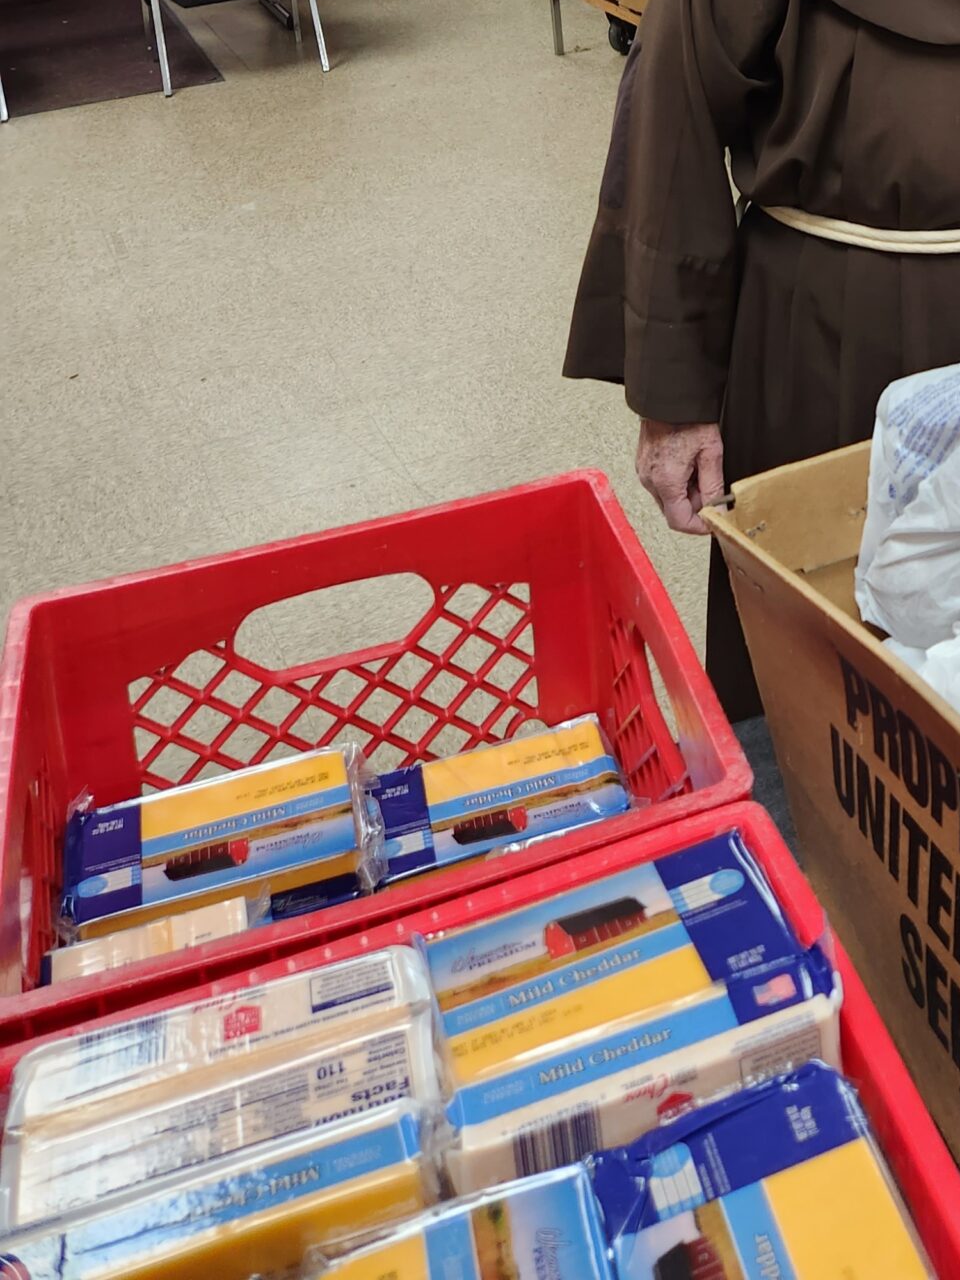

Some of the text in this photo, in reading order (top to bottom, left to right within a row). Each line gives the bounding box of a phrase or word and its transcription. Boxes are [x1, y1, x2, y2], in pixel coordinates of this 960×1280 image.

[464, 775, 555, 807] Mild Cheddar
[182, 805, 287, 842] Mild Cheddar
[507, 948, 642, 1009] Mild Cheddar
[316, 1061, 345, 1080] 110
[538, 1057, 585, 1087] Mild
[589, 1026, 673, 1066] Cheddar
[350, 1076, 410, 1103] Facts
